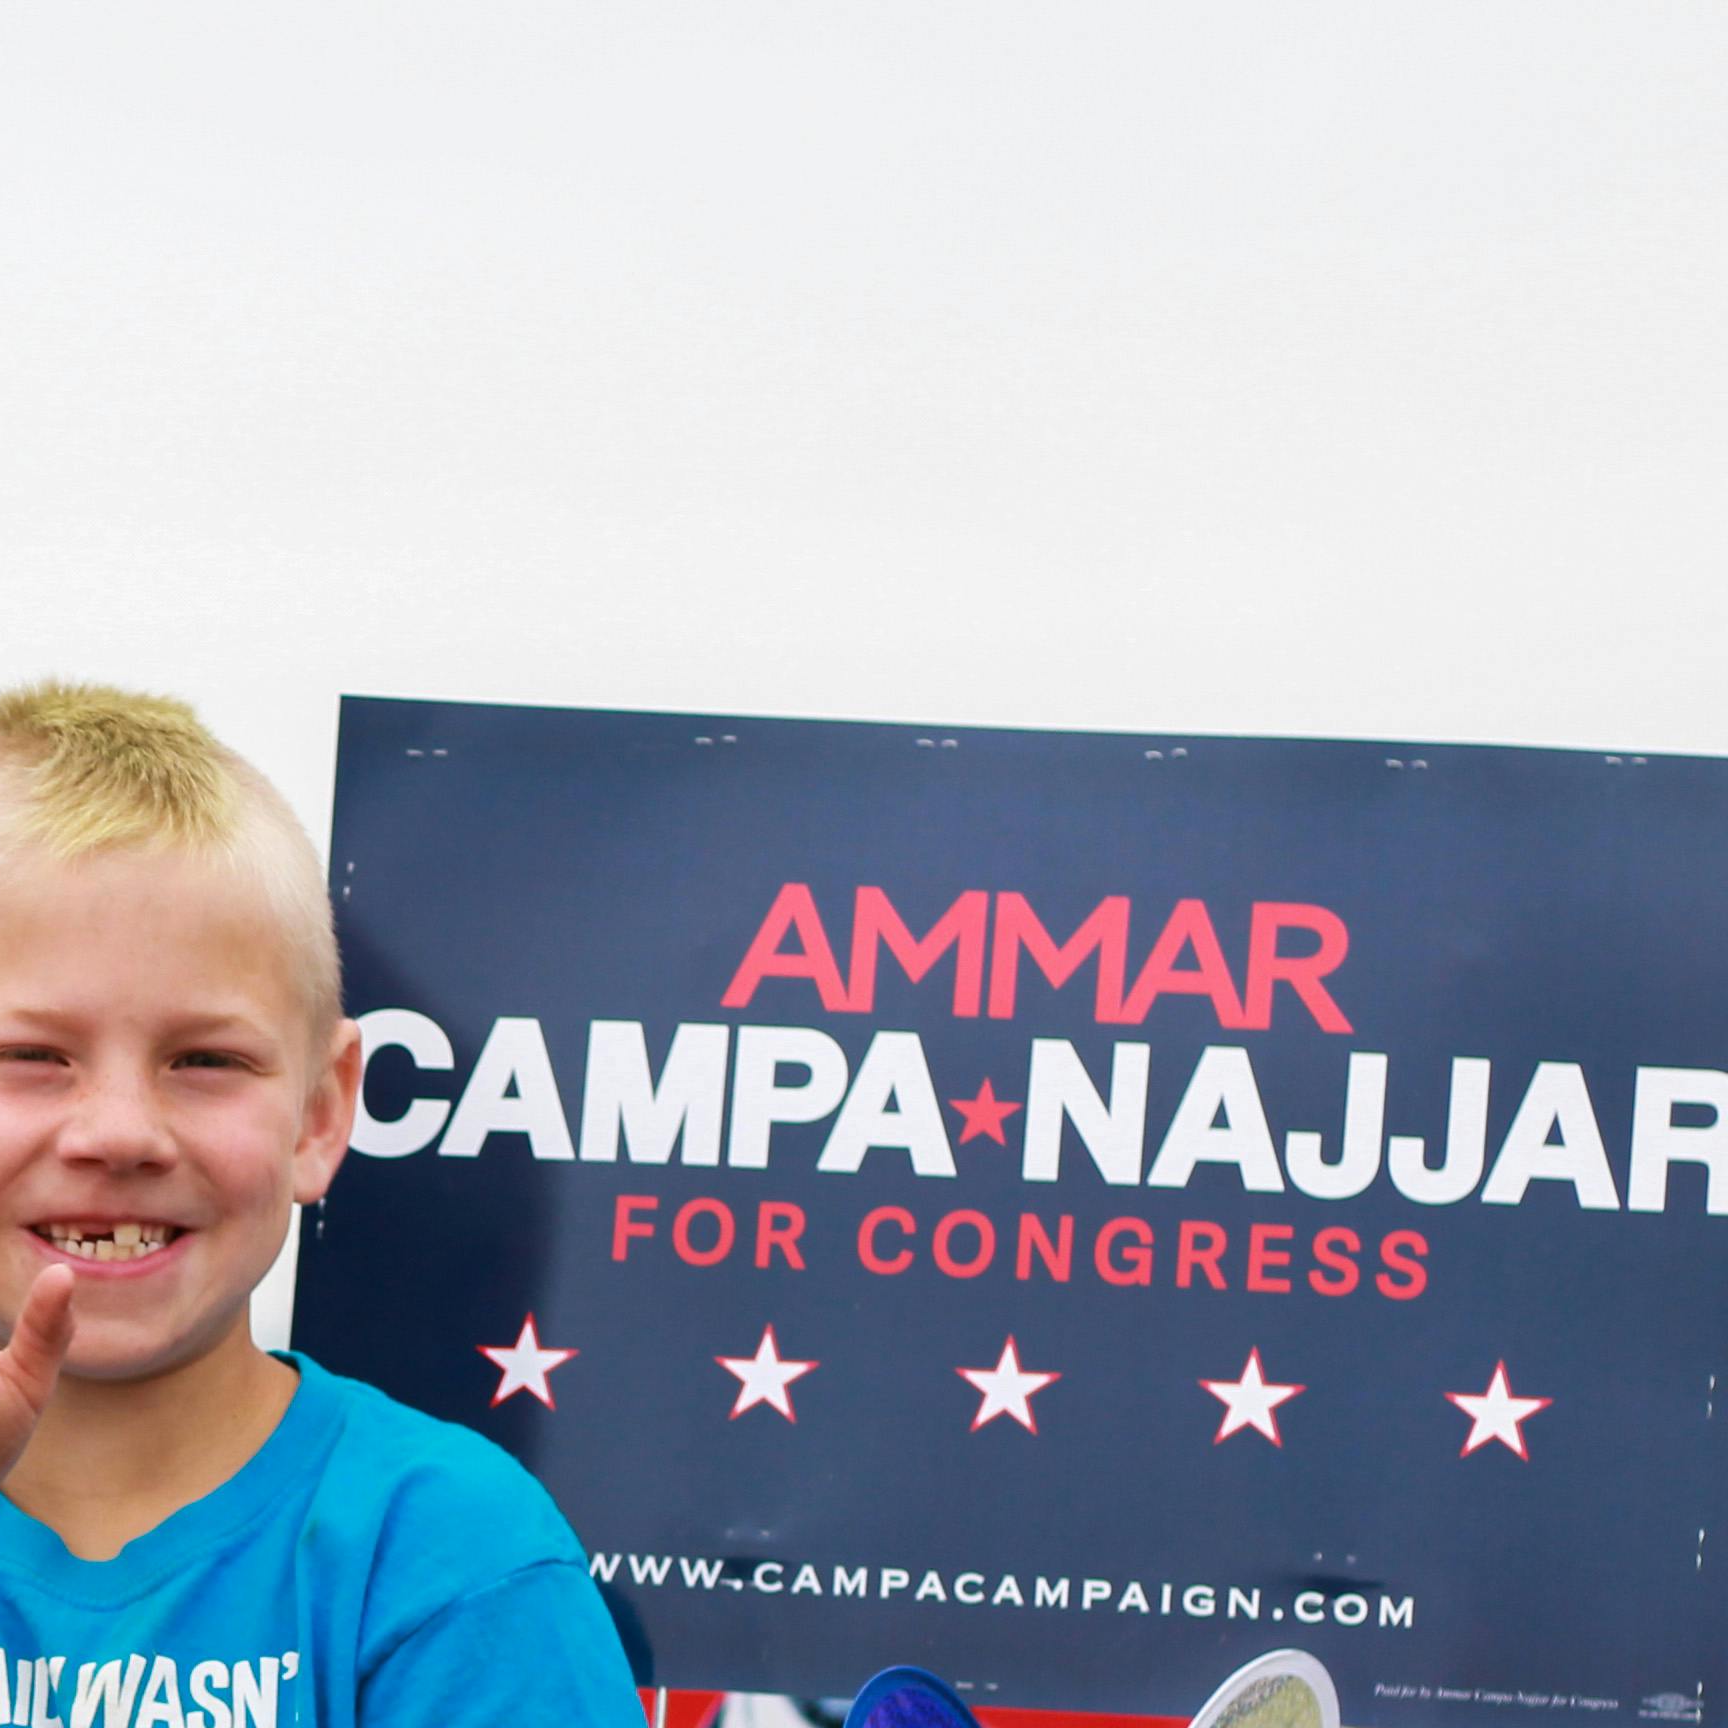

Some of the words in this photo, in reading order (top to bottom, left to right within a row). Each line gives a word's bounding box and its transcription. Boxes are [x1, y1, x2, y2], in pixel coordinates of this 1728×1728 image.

[720, 883, 1353, 1034] AMMAR
[344, 1009, 956, 1177] CAMPA
[1023, 1038, 1728, 1215] NAJJAR
[612, 1195, 805, 1269] FOR
[858, 1206, 1429, 1300] CONGRESS
[590, 1551, 1415, 1628] WWW.CAMPACAMPAIGN.COM
